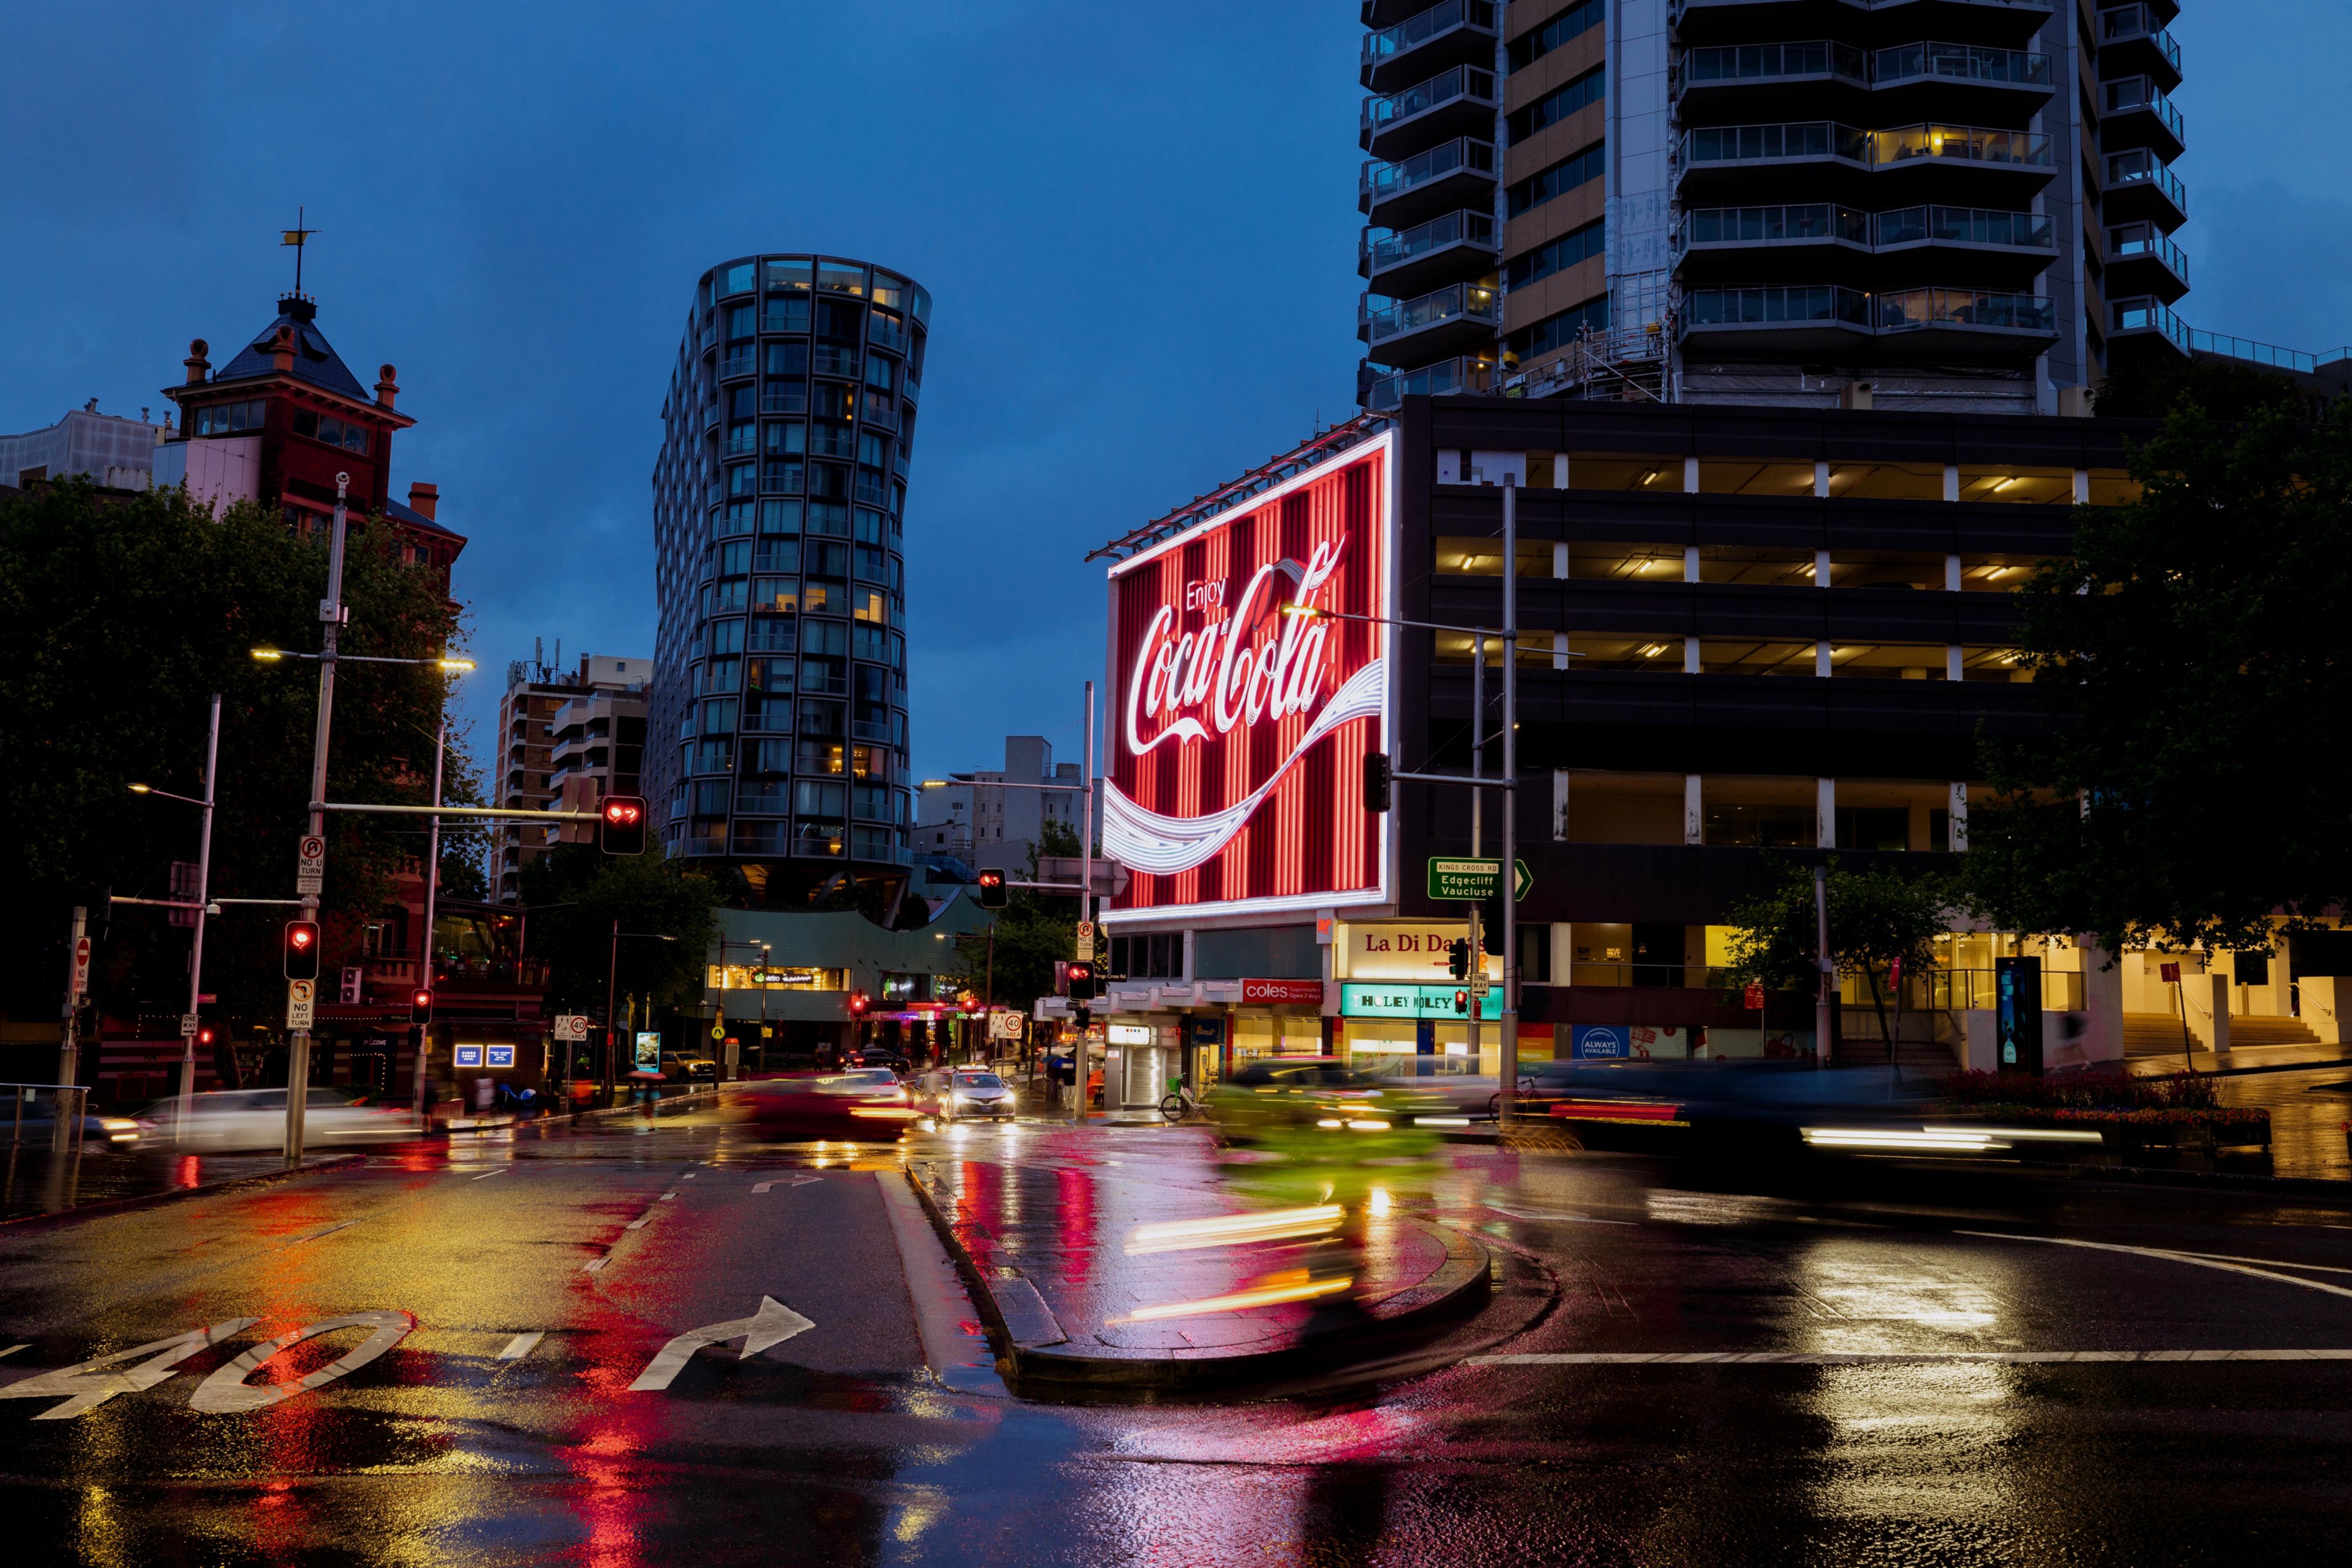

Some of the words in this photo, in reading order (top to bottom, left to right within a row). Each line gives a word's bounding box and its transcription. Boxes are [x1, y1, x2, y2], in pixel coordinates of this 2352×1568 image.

[1186, 577, 1227, 613] Enjoy
[1127, 530, 1350, 755] Coca-Cola
[1441, 875, 1494, 887] Edgecliff
[1441, 886, 1494, 897] Vaucluse
[1365, 934, 1391, 952] La
[1397, 934, 1420, 952] Di
[78, 969, 85, 978] NO
[1247, 983, 1288, 998] coles
[1362, 995, 1409, 1008] HOLEY
[1414, 997, 1452, 1009] MOLEY
[0, 1310, 417, 1419] 40
